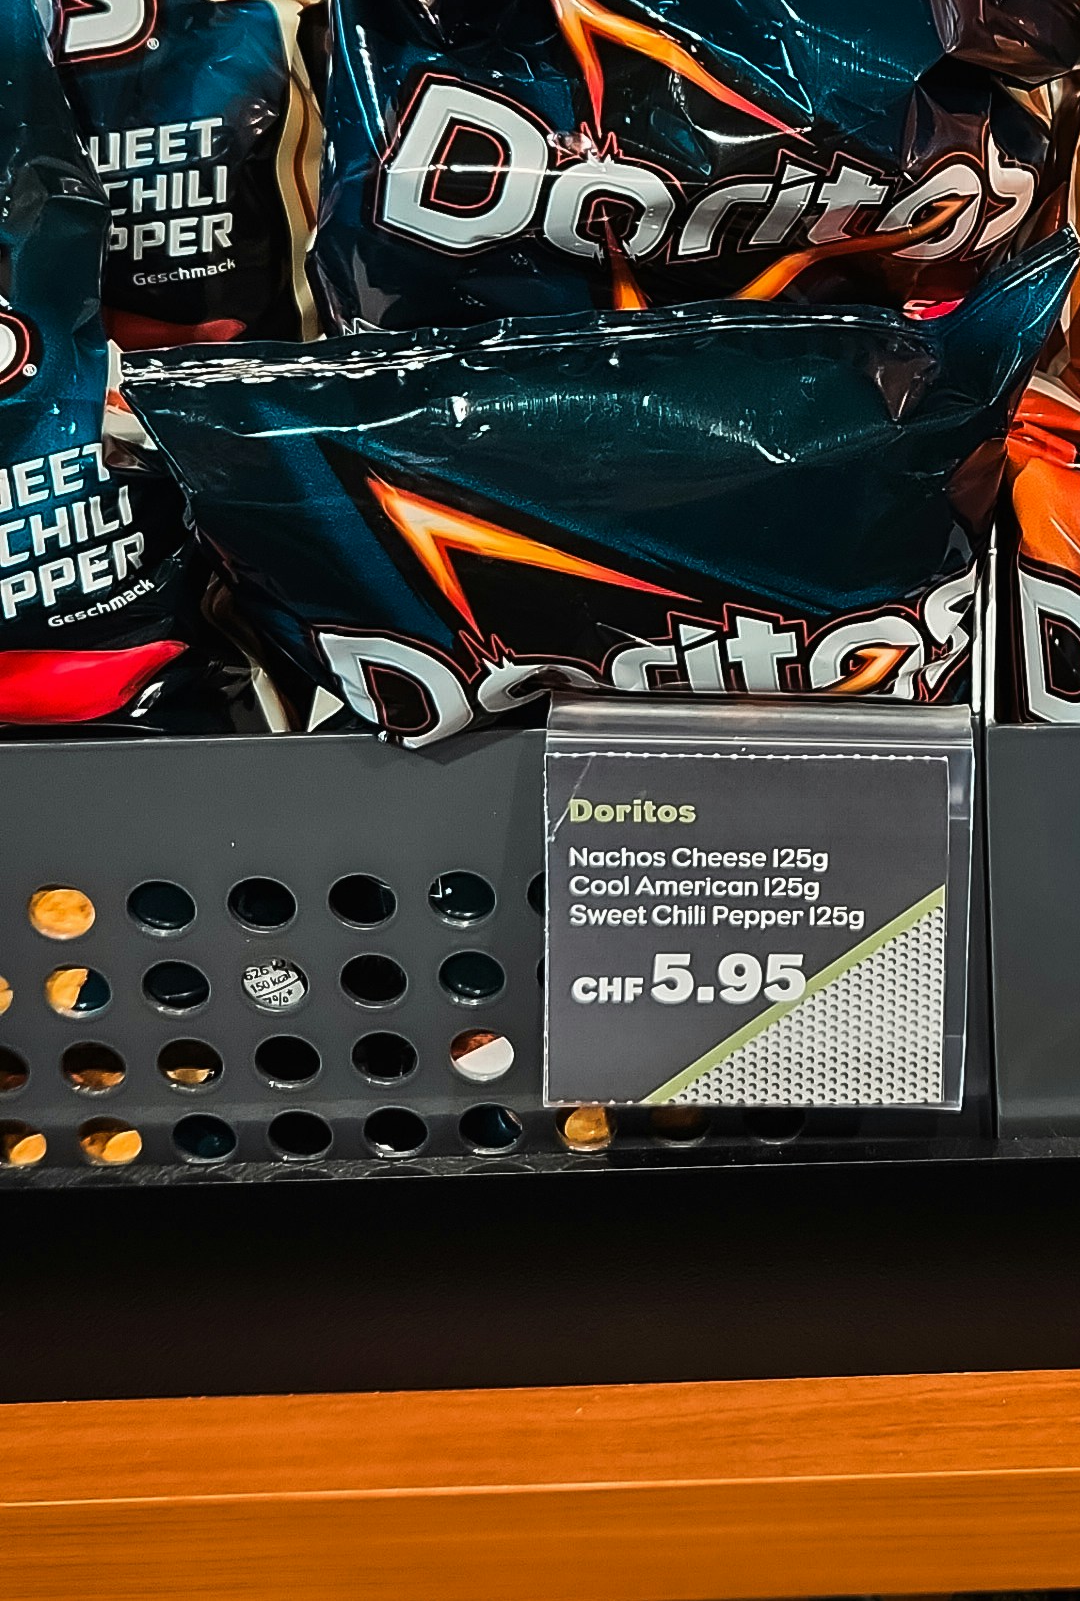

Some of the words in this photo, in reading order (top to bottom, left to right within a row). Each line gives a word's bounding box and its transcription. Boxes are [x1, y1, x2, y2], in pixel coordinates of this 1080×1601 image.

[132, 258, 236, 286] Geschmack
[1, 531, 145, 620] PPER
[48, 577, 155, 628] Geschmack
[568, 798, 697, 823] Doritos
[568, 846, 666, 869] Nachos
[671, 847, 767, 869] Cheese
[772, 848, 829, 872] 125g
[568, 875, 630, 898] Cool
[635, 875, 759, 898] American
[764, 877, 820, 901] 125g
[569, 904, 647, 926] Sweet
[651, 904, 706, 926] Chili
[712, 905, 804, 930] Pepper
[809, 906, 865, 930] 125g
[249, 980, 270, 994] 150
[269, 969, 292, 987] kcal
[571, 976, 644, 1004] CHF
[651, 952, 808, 1005] 5.95
